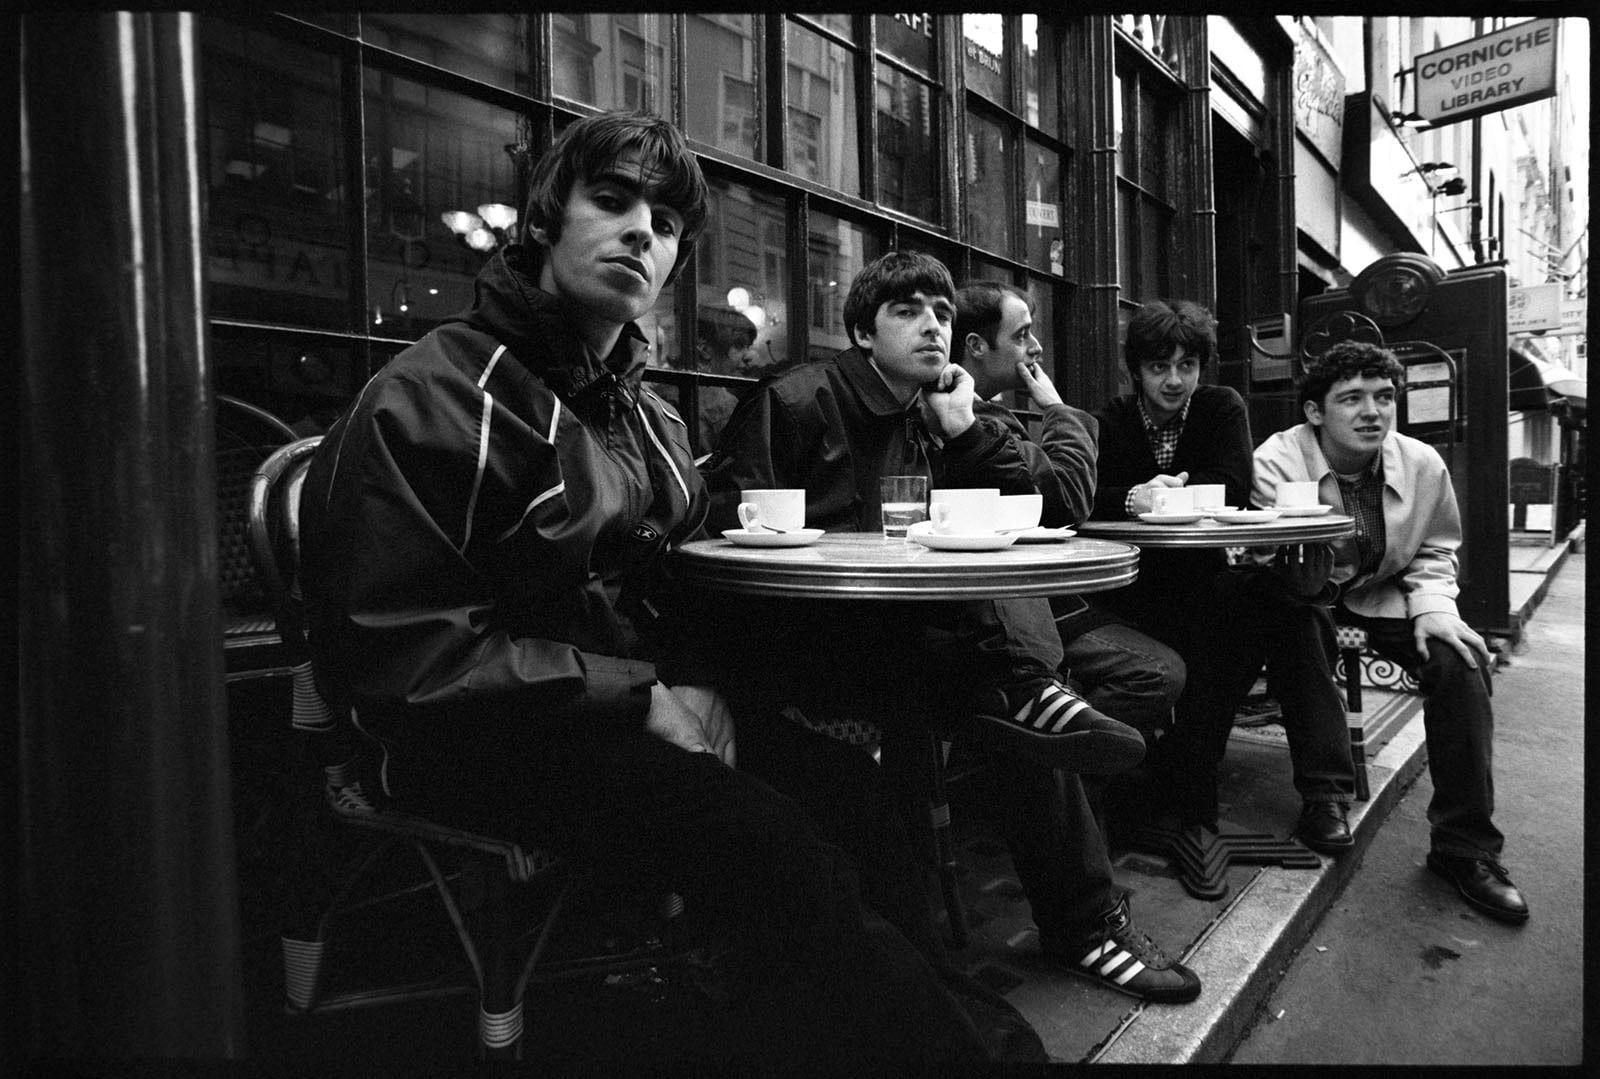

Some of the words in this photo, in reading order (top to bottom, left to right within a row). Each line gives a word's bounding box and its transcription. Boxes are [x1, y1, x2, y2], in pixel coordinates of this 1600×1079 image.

[1421, 27, 1551, 80] CORNICHE
[1450, 62, 1512, 91] VIDEO
[1441, 77, 1524, 111] LIBRARY
